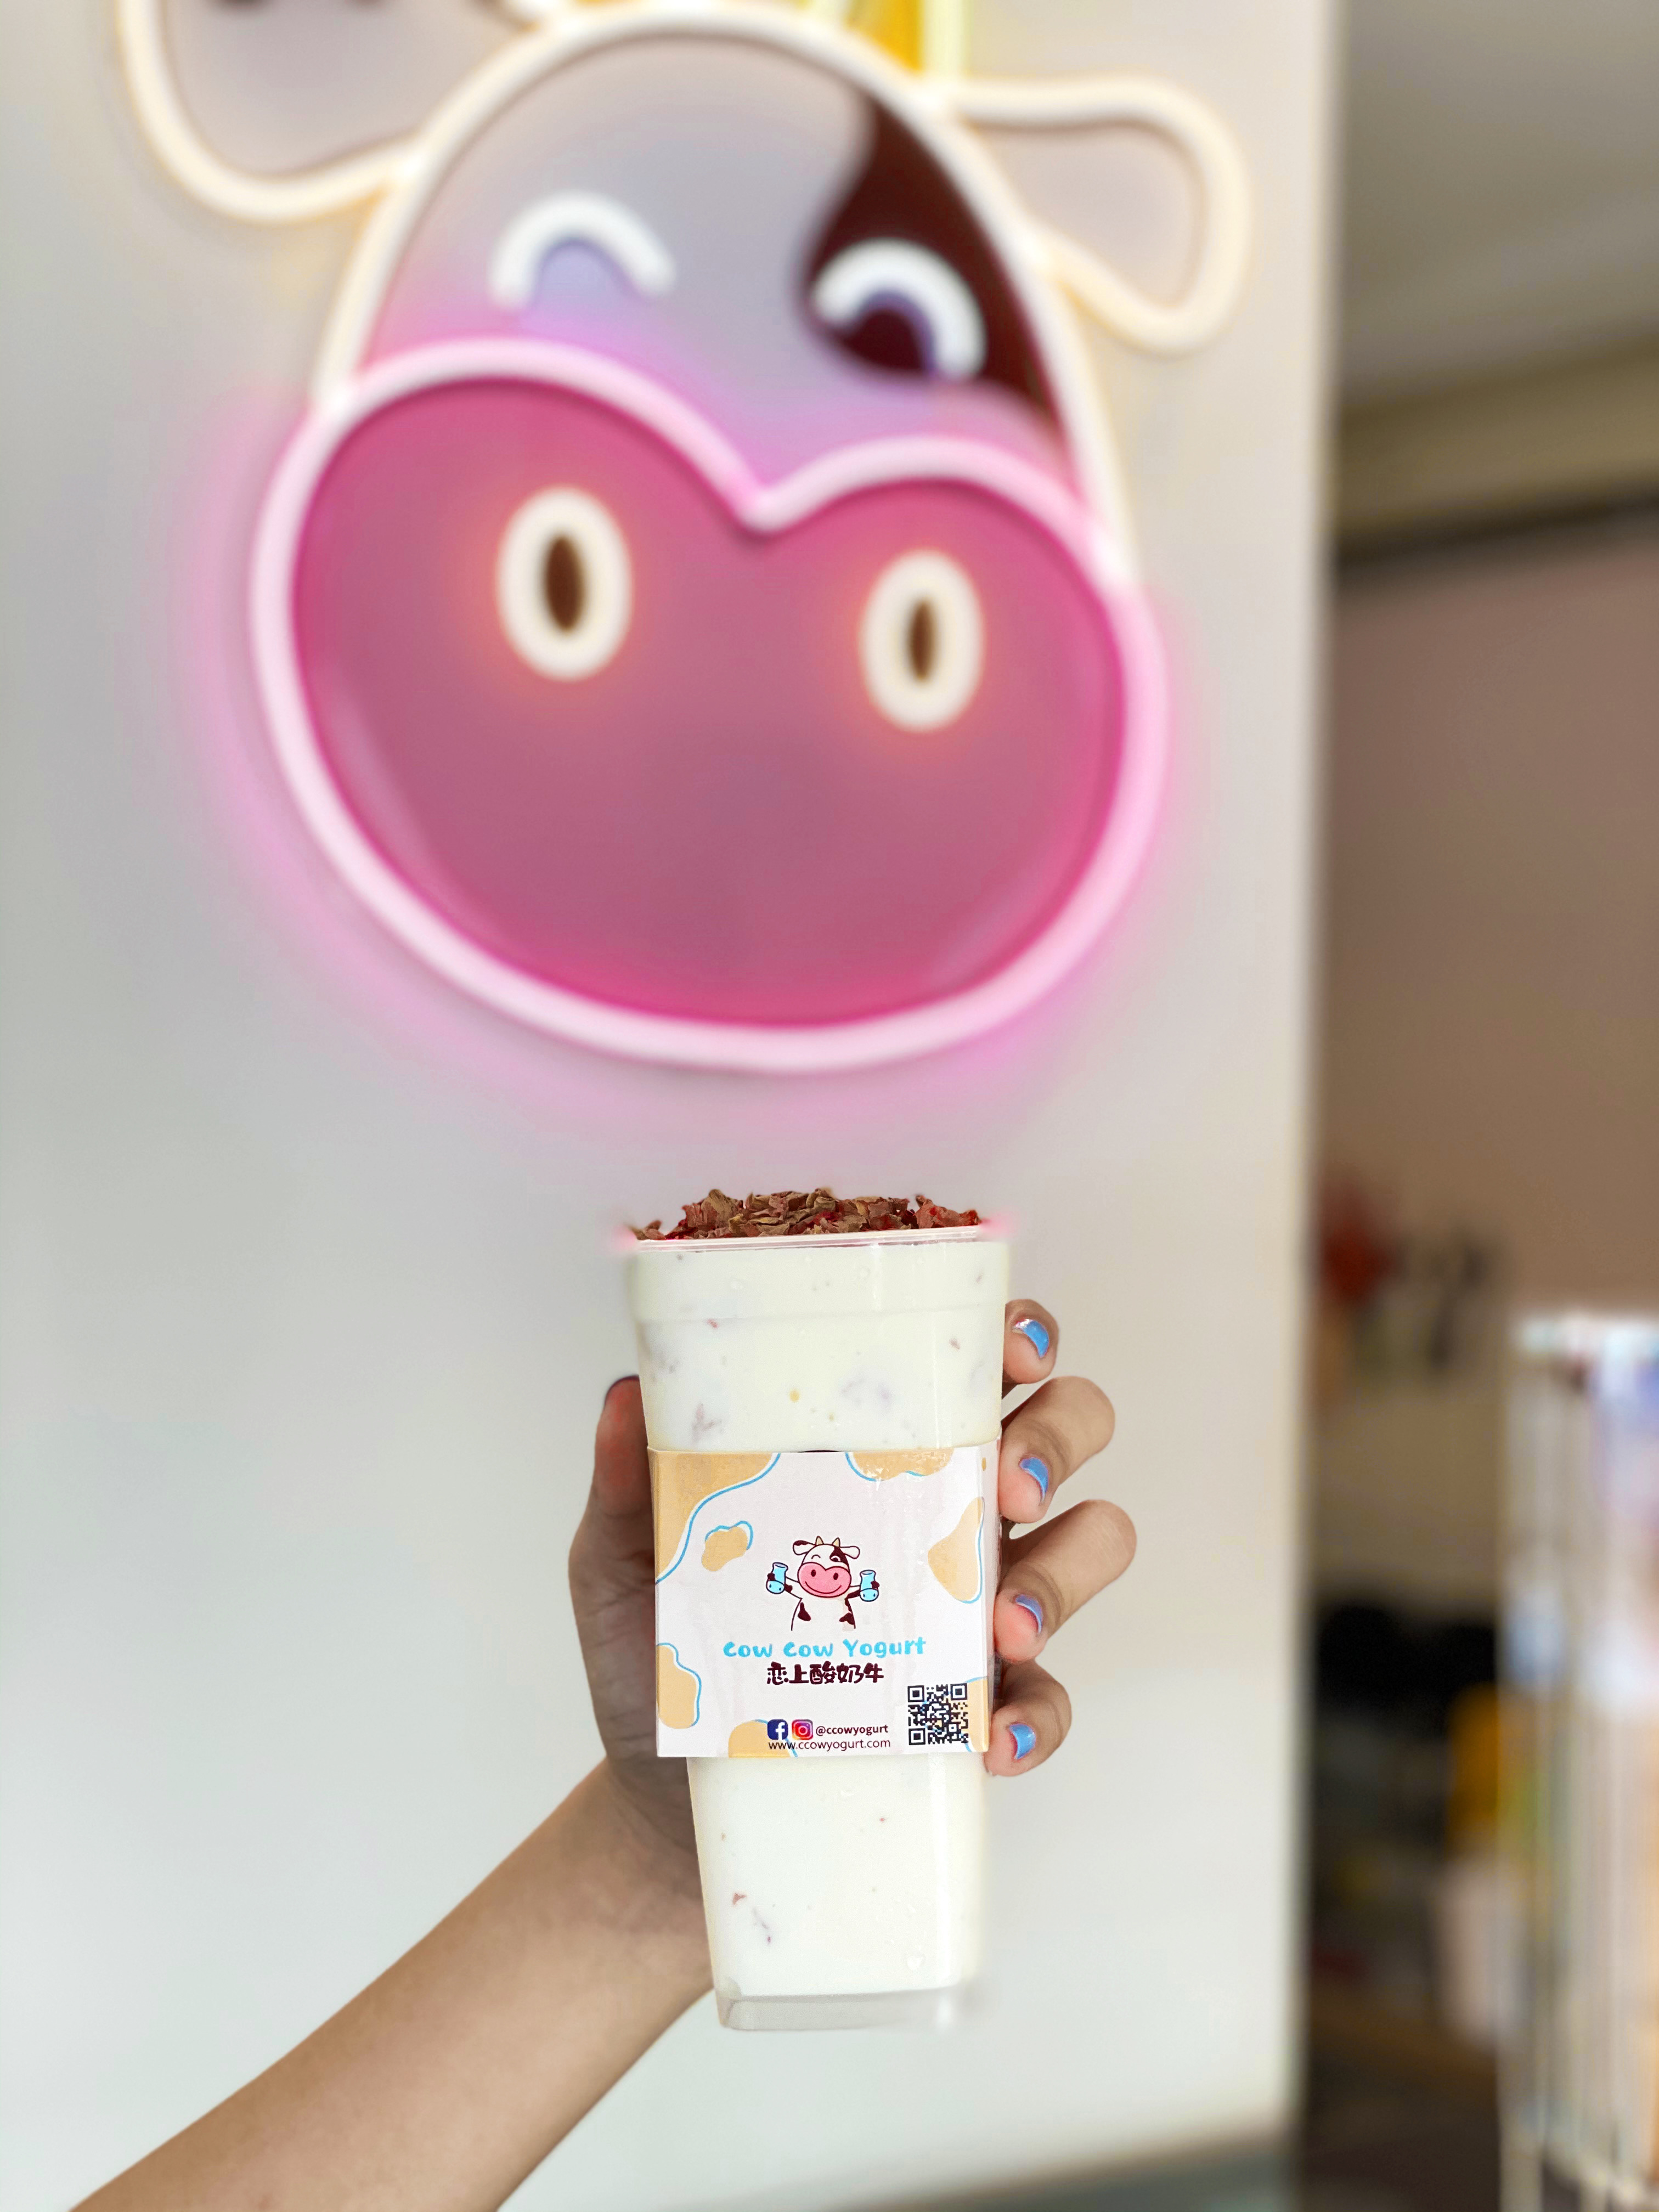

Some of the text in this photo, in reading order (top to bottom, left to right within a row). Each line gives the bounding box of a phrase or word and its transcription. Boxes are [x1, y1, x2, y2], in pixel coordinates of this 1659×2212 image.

[723, 1637, 926, 1658] Cow Cow Yogurt
[767, 1661, 884, 1685] 恋上酸奶牛
[815, 1724, 888, 1736] @ccowyogurt
[768, 1739, 890, 1752] www.ccowyogurt.com
